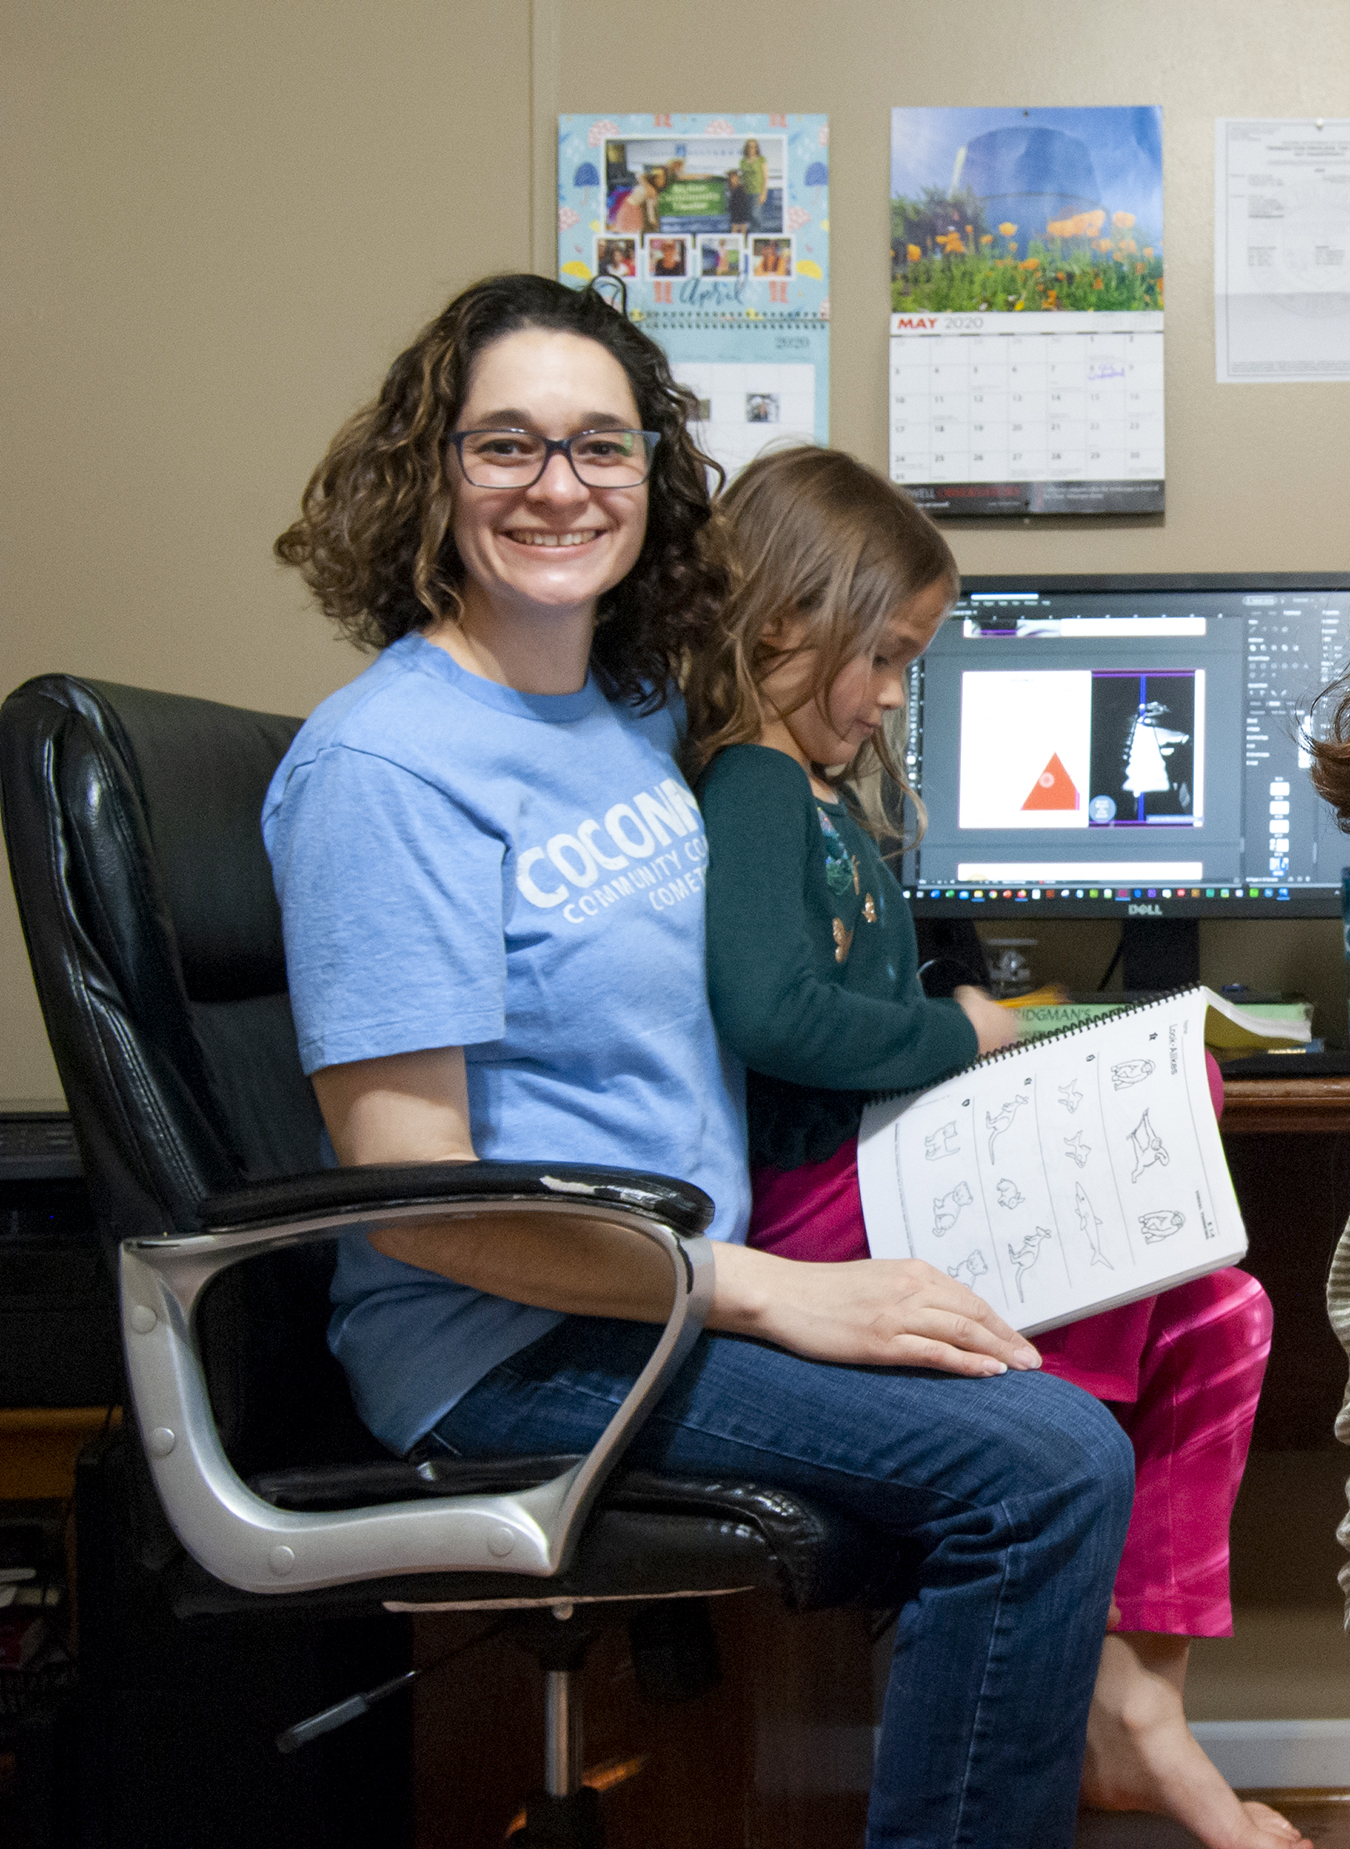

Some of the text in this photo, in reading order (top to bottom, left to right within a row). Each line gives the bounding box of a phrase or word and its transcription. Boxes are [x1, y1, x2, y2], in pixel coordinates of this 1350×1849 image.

[679, 277, 744, 305] April
[897, 316, 984, 329] MAY 2020
[563, 850, 681, 923] COMMUNITY
[1128, 904, 1162, 916] DELL
